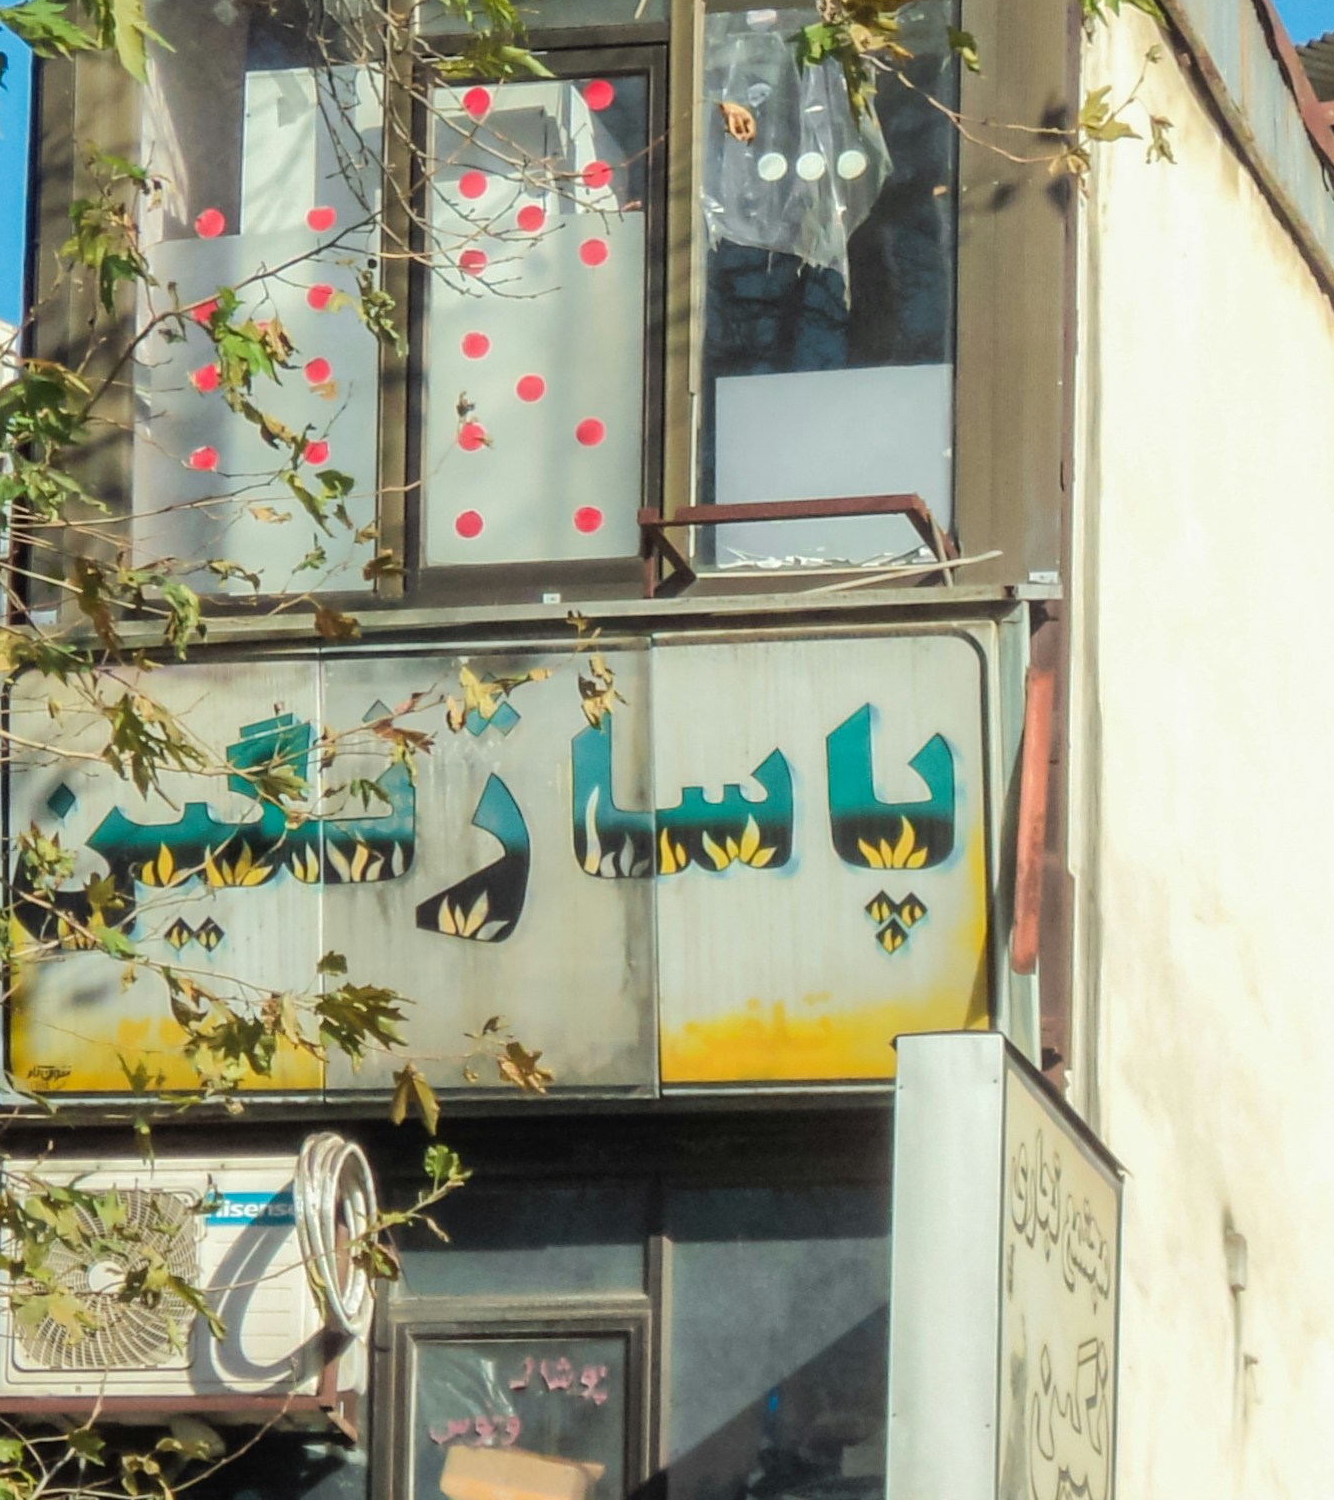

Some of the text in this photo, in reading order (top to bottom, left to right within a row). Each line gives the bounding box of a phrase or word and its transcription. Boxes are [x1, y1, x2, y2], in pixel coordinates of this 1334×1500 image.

[9, 672, 957, 955] پاساژ نگین
[1010, 1128, 1110, 1315] مجتمع تجاری
